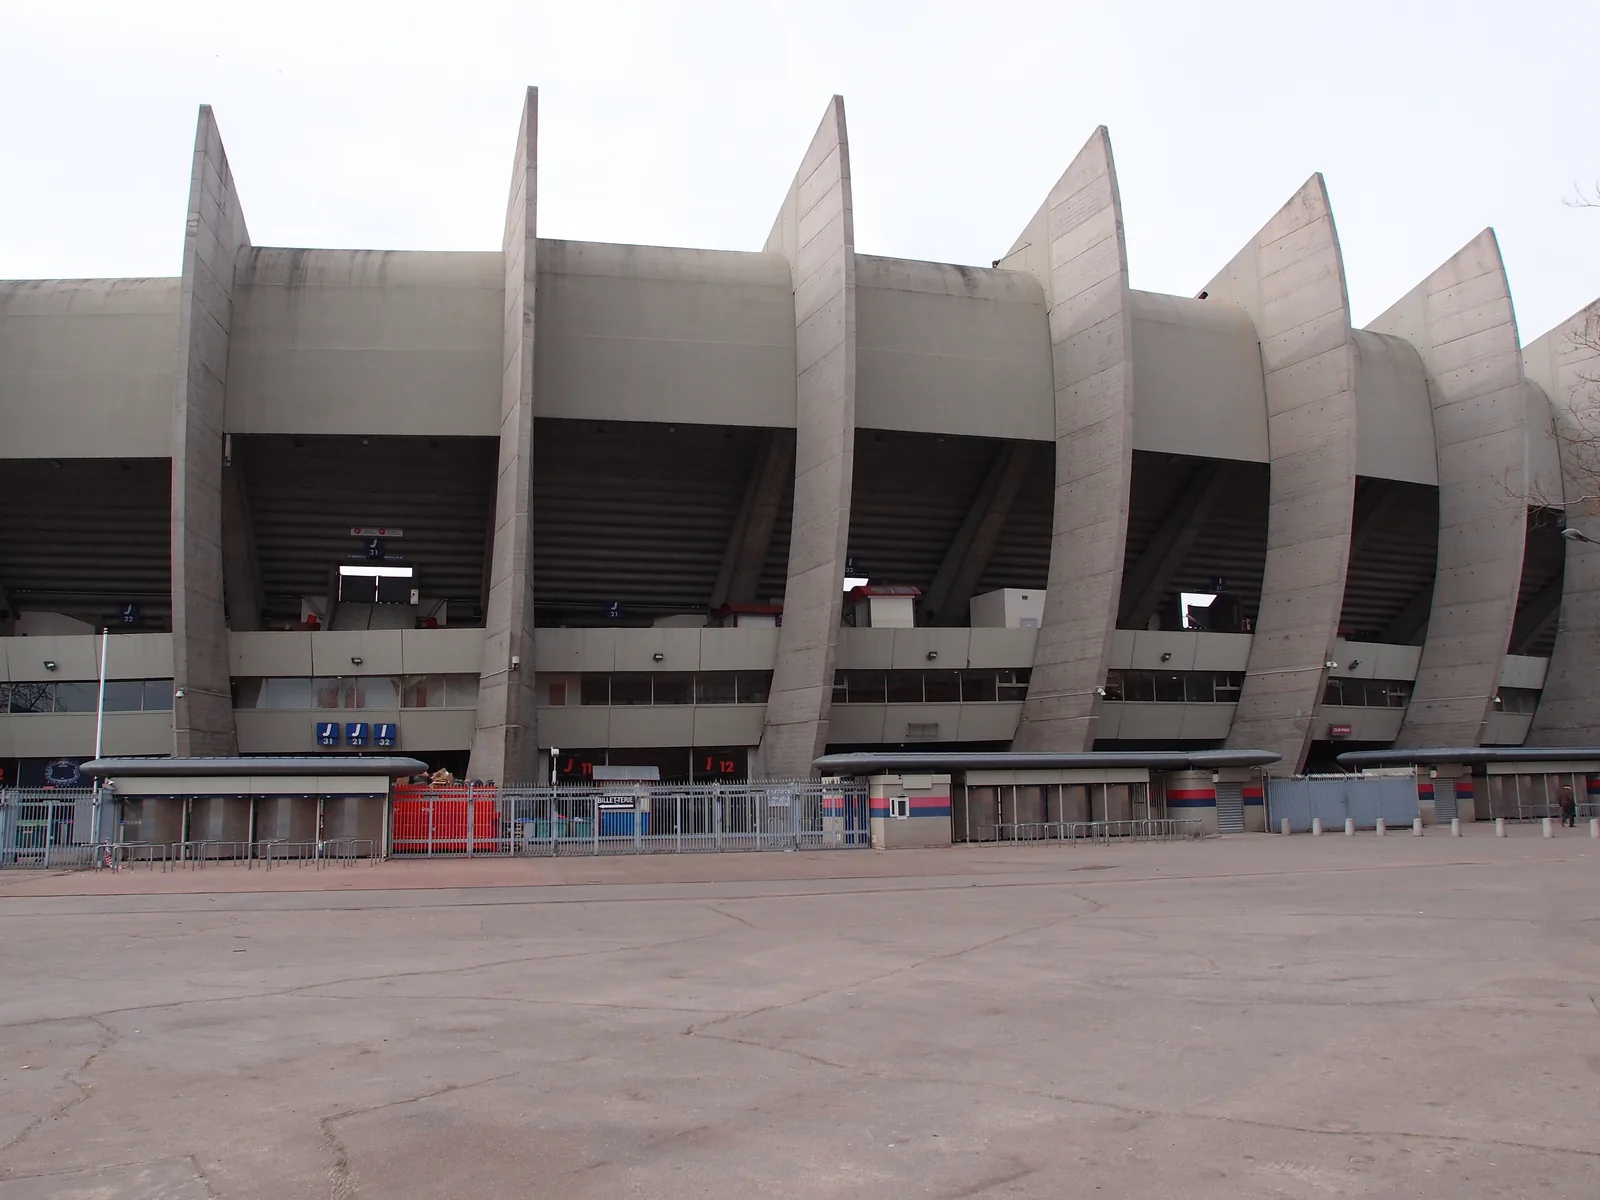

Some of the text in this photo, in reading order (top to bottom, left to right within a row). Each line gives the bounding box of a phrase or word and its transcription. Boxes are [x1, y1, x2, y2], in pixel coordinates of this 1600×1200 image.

[370, 539, 377, 548] J
[123, 604, 132, 615] J
[611, 601, 618, 610] J
[322, 723, 332, 737] J
[351, 723, 361, 737] J
[380, 724, 387, 738] I
[379, 738, 390, 746] 32
[563, 758, 573, 773] J
[720, 760, 735, 773] 12
